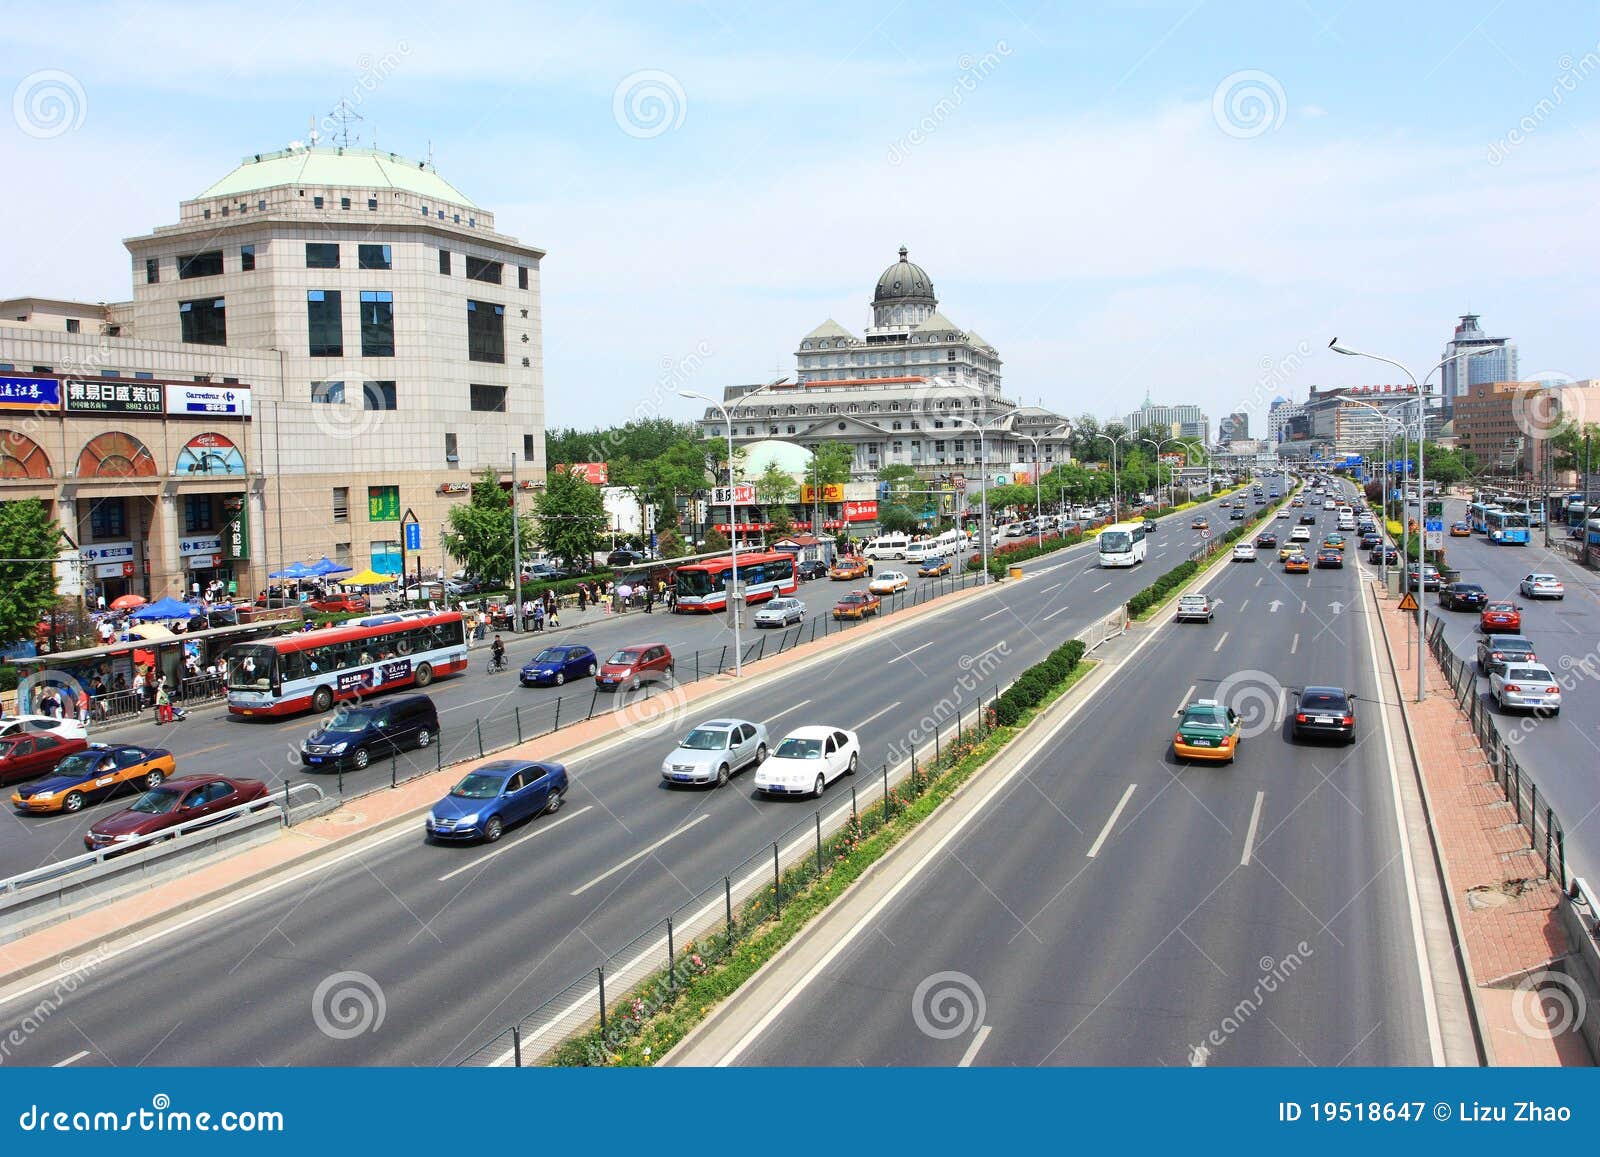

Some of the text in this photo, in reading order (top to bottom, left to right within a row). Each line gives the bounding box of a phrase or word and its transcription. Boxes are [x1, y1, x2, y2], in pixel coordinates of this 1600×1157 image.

[70, 383, 160, 402] 東易日盛装饰
[186, 391, 220, 399] Carrefour
[125, 402, 160, 411] 8802 6134
